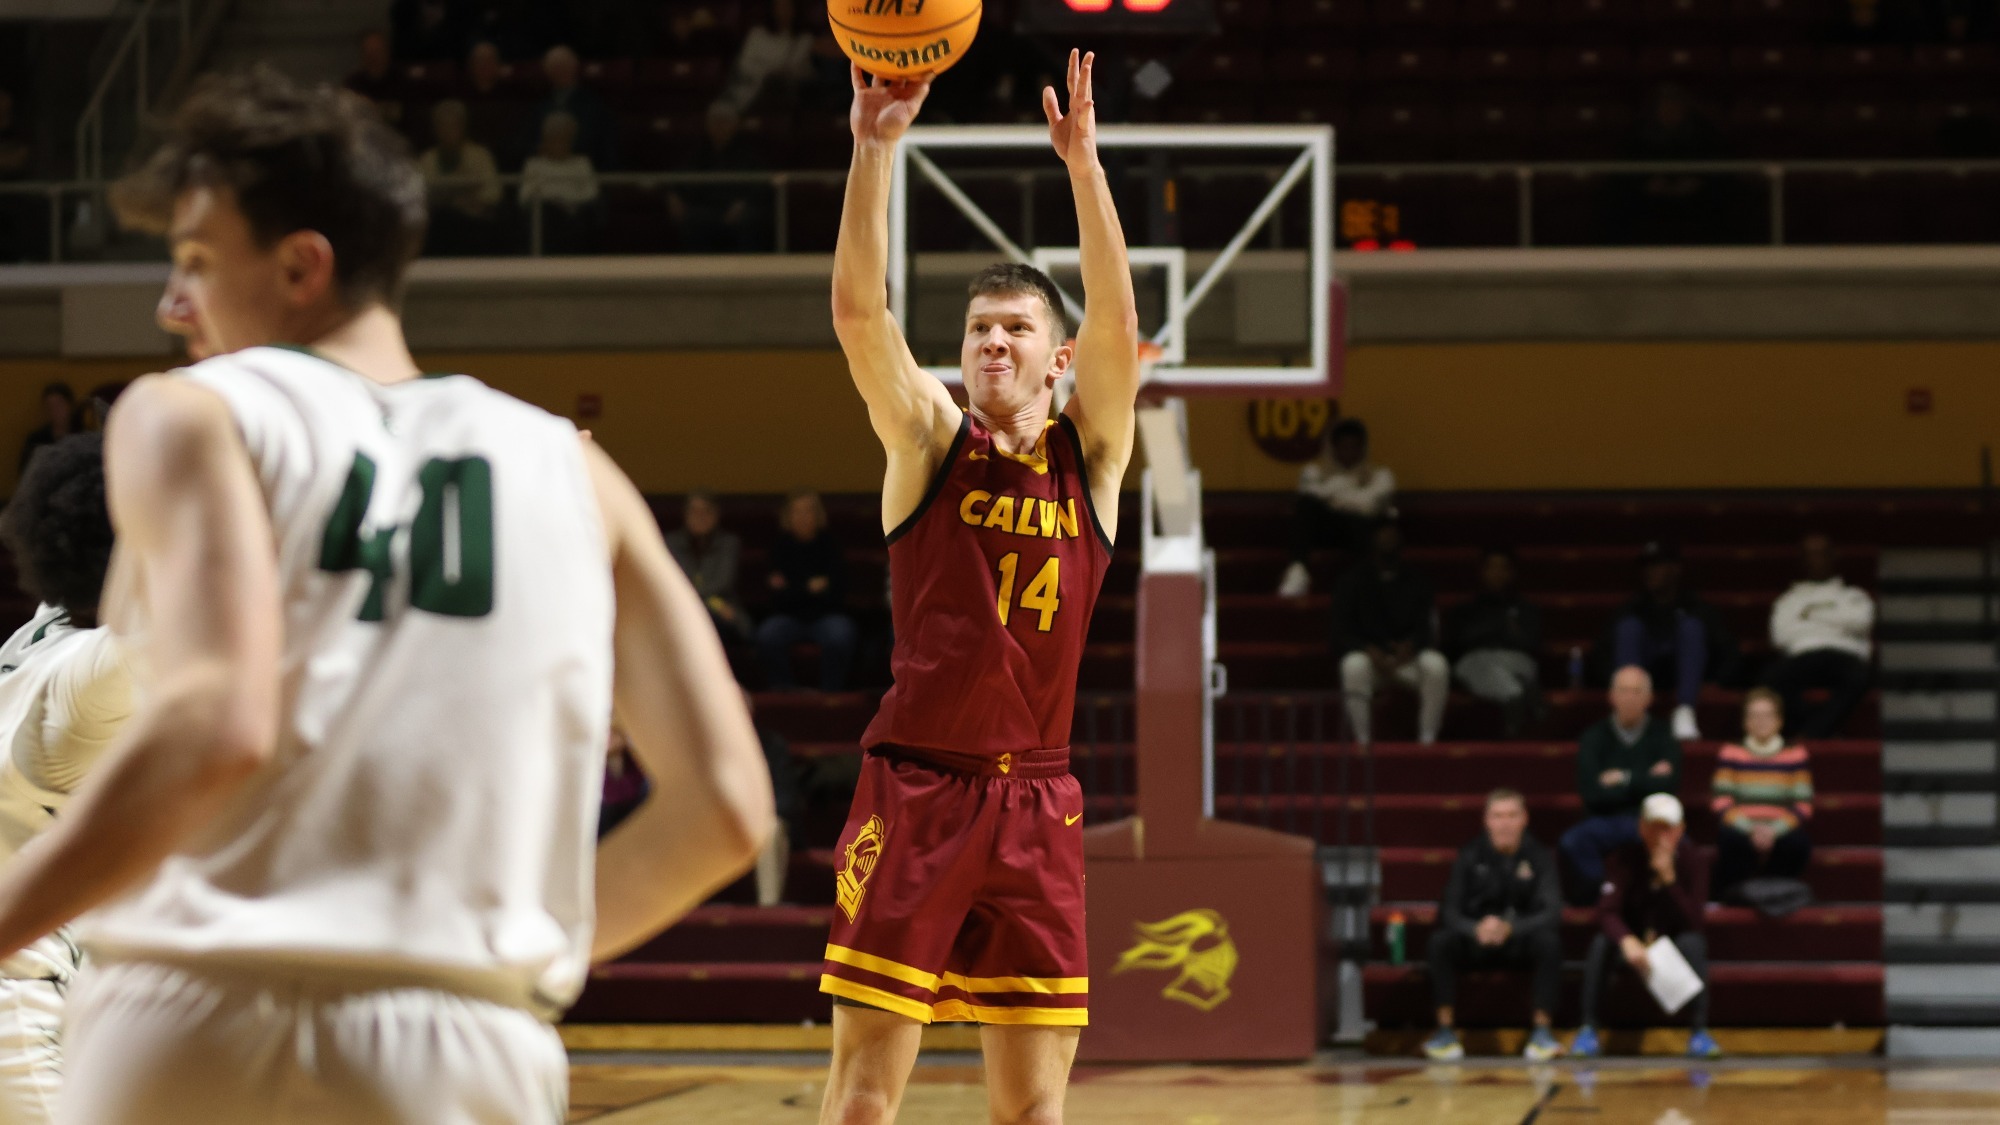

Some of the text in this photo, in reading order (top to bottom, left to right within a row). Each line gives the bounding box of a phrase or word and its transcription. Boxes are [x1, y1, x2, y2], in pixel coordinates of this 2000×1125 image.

[849, 37, 951, 69] Wilson
[1257, 398, 1329, 438] 109
[319, 450, 494, 622] 40
[997, 552, 1060, 632] 14
